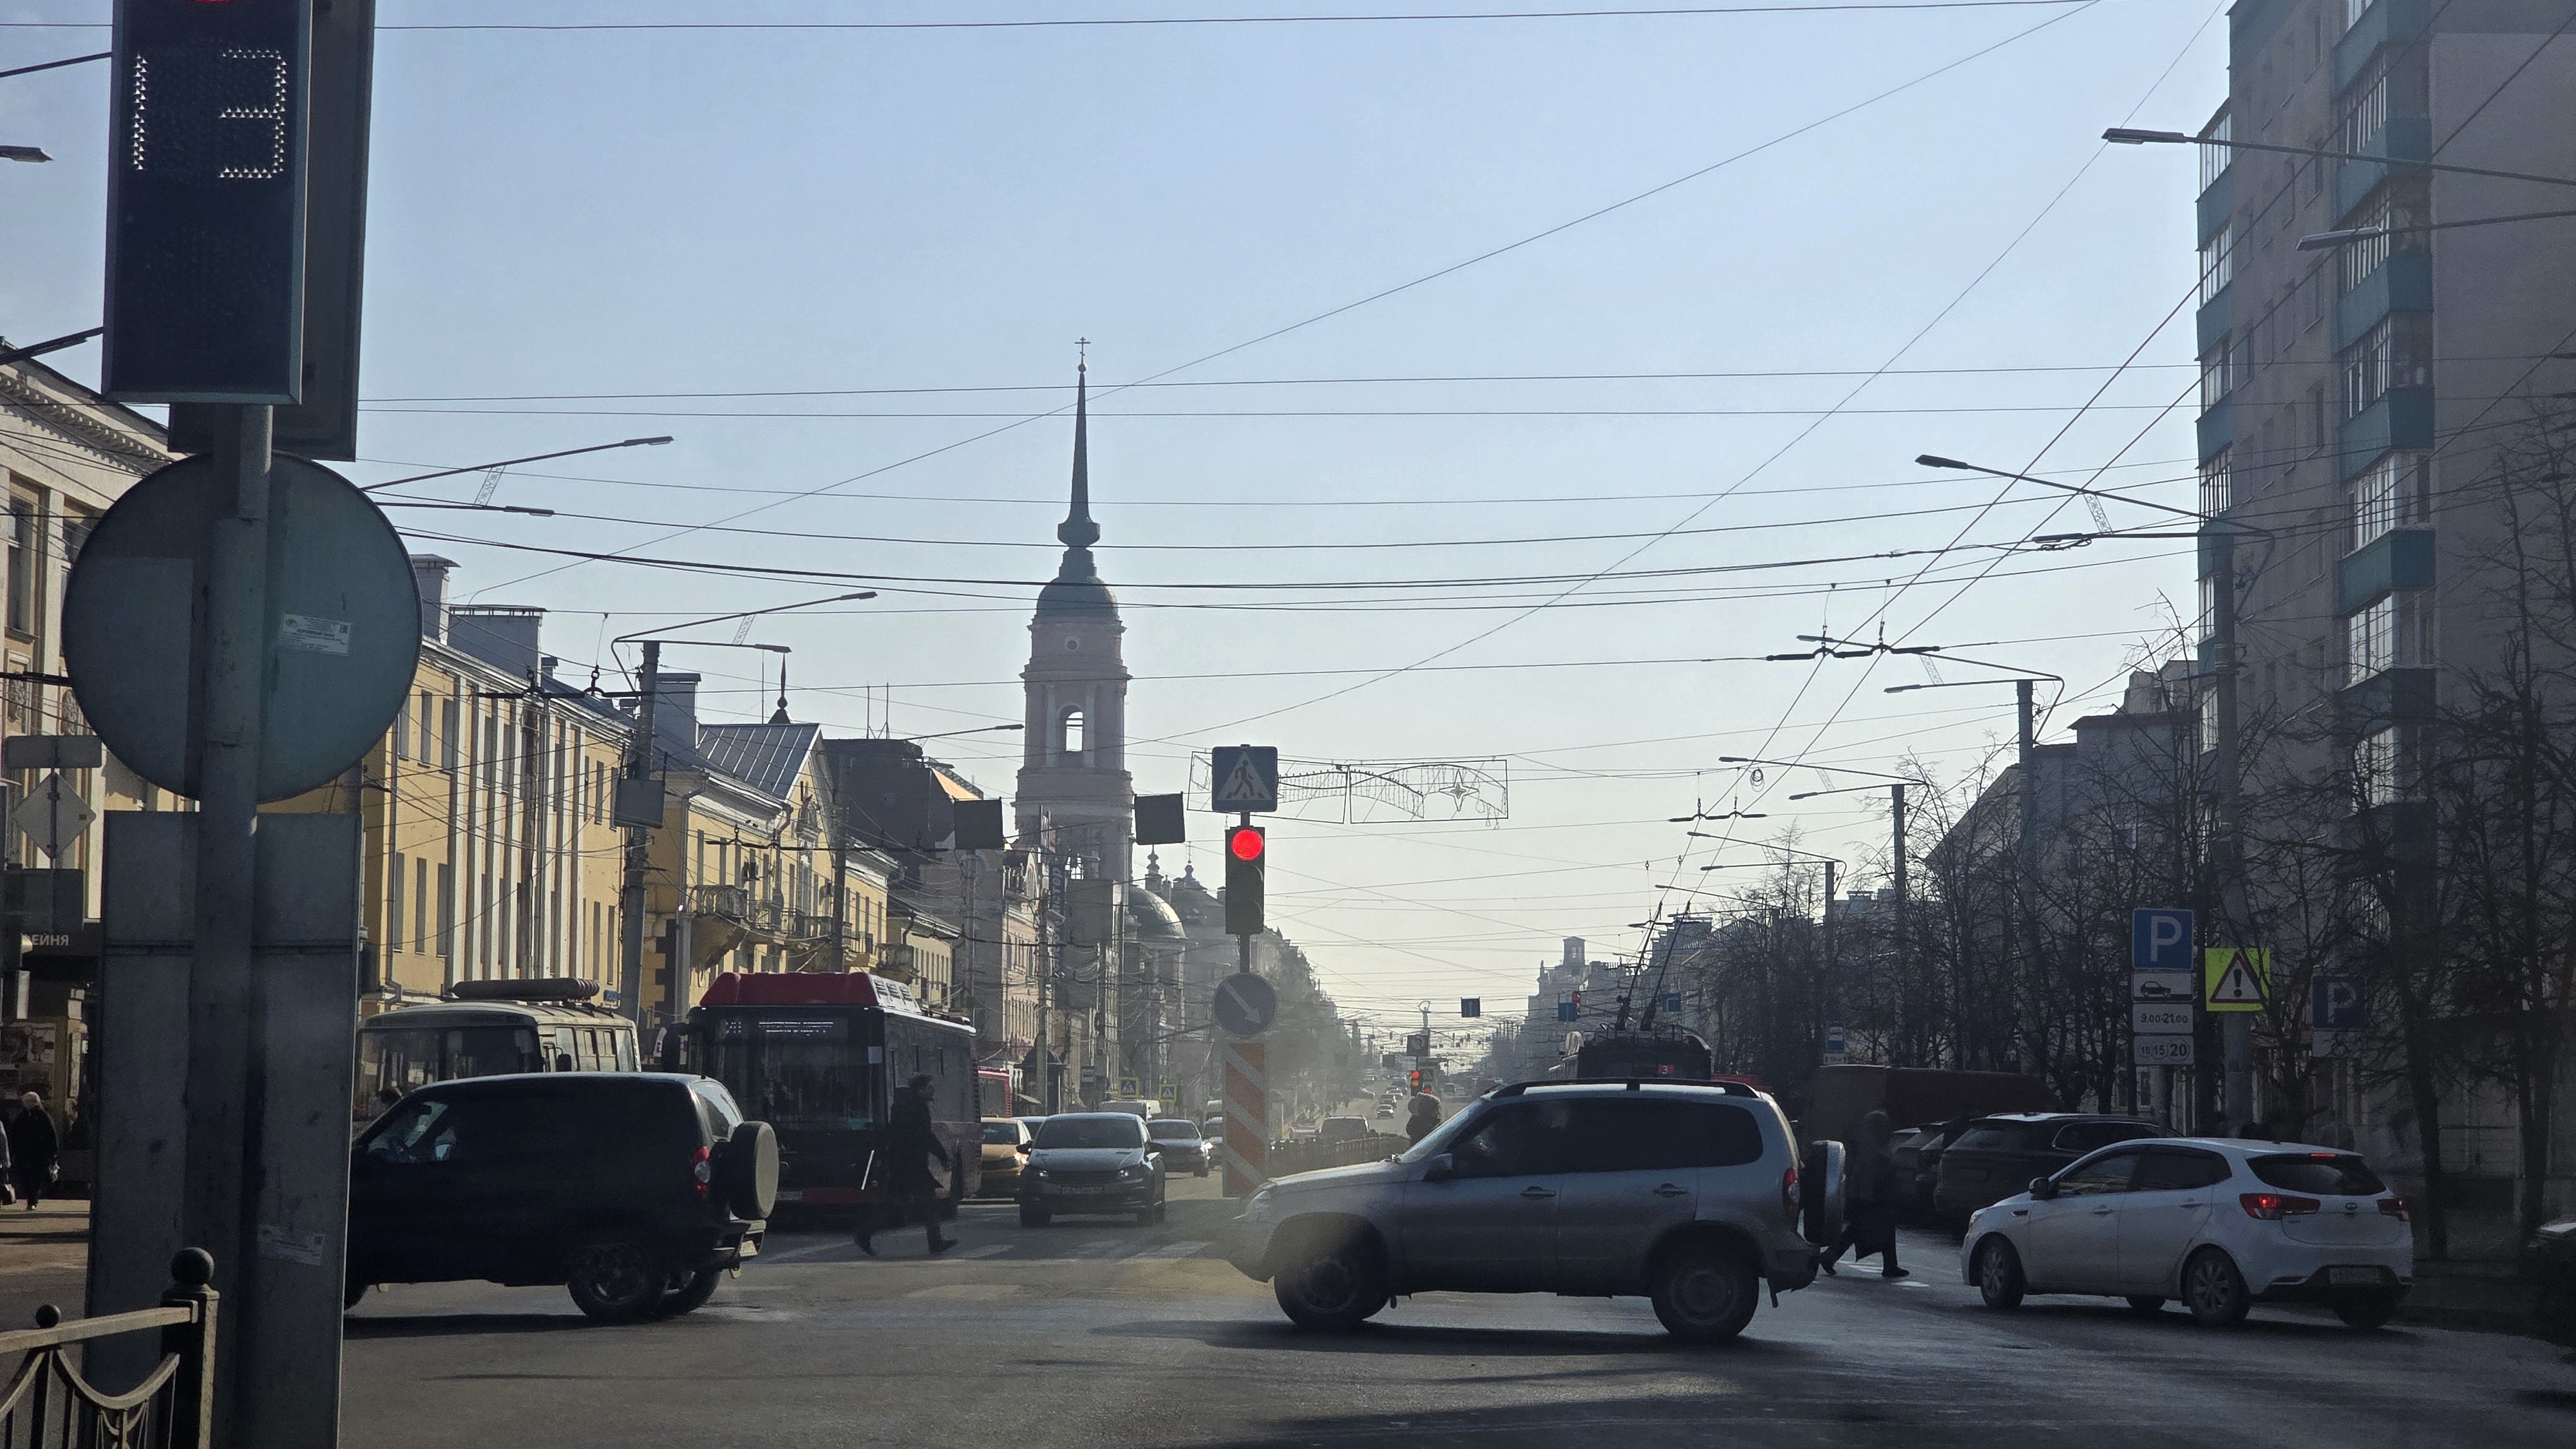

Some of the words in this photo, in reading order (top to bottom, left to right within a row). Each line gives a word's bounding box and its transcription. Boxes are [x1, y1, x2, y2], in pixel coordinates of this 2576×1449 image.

[32, 933, 69, 946] ЕЙНЯ
[2150, 916, 2183, 962] P
[2327, 981, 2357, 1023] P
[2154, 1045, 2165, 1056] 15
[2170, 1043, 2188, 1057] 20
[1662, 1065, 1668, 1075] 3
